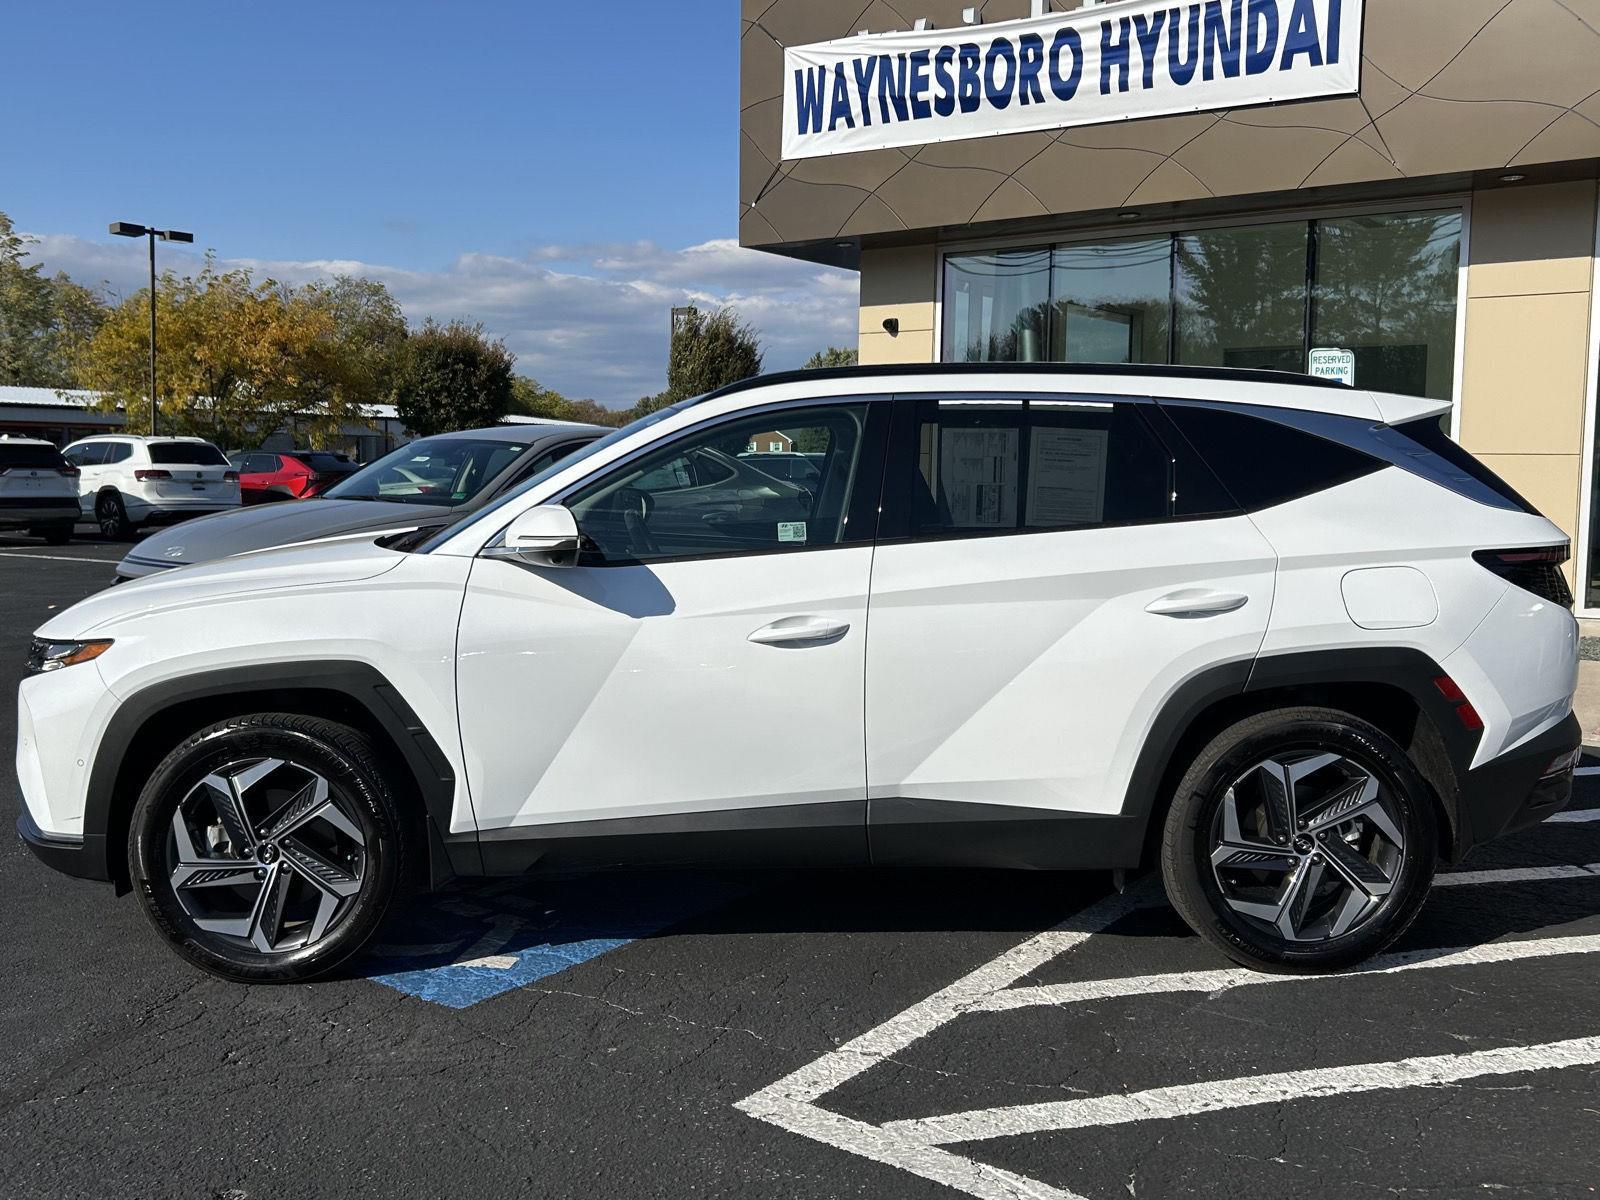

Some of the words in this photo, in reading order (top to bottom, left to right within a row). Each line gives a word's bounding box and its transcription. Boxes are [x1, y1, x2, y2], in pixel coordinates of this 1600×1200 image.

[794, 27, 1084, 136] WAYNESBORO
[1099, 0, 1342, 95] HYUNDAI
[1312, 354, 1351, 365] RESERVED
[1315, 366, 1349, 376] PARKING
